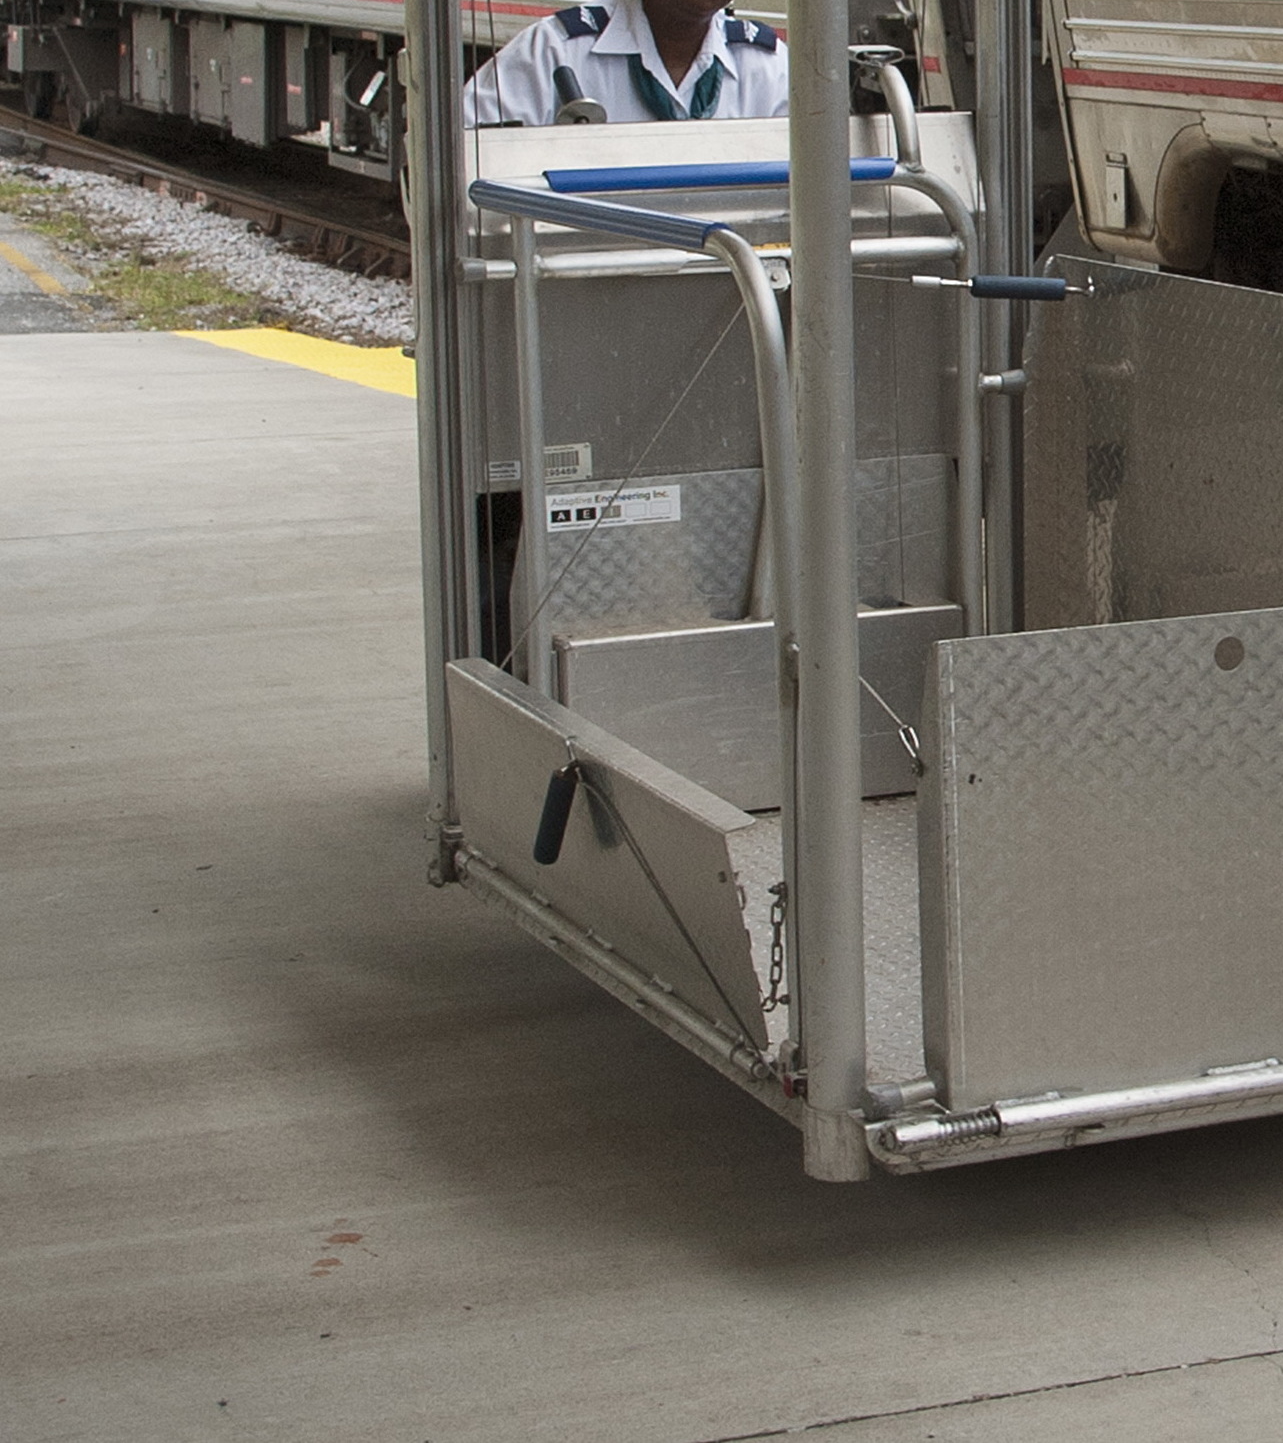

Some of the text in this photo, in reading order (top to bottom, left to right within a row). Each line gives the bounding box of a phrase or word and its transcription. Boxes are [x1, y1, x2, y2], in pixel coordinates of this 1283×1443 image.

[551, 490, 670, 507] Adaptive Engneering Inc.
[557, 512, 566, 521] A
[583, 509, 591, 519] E
